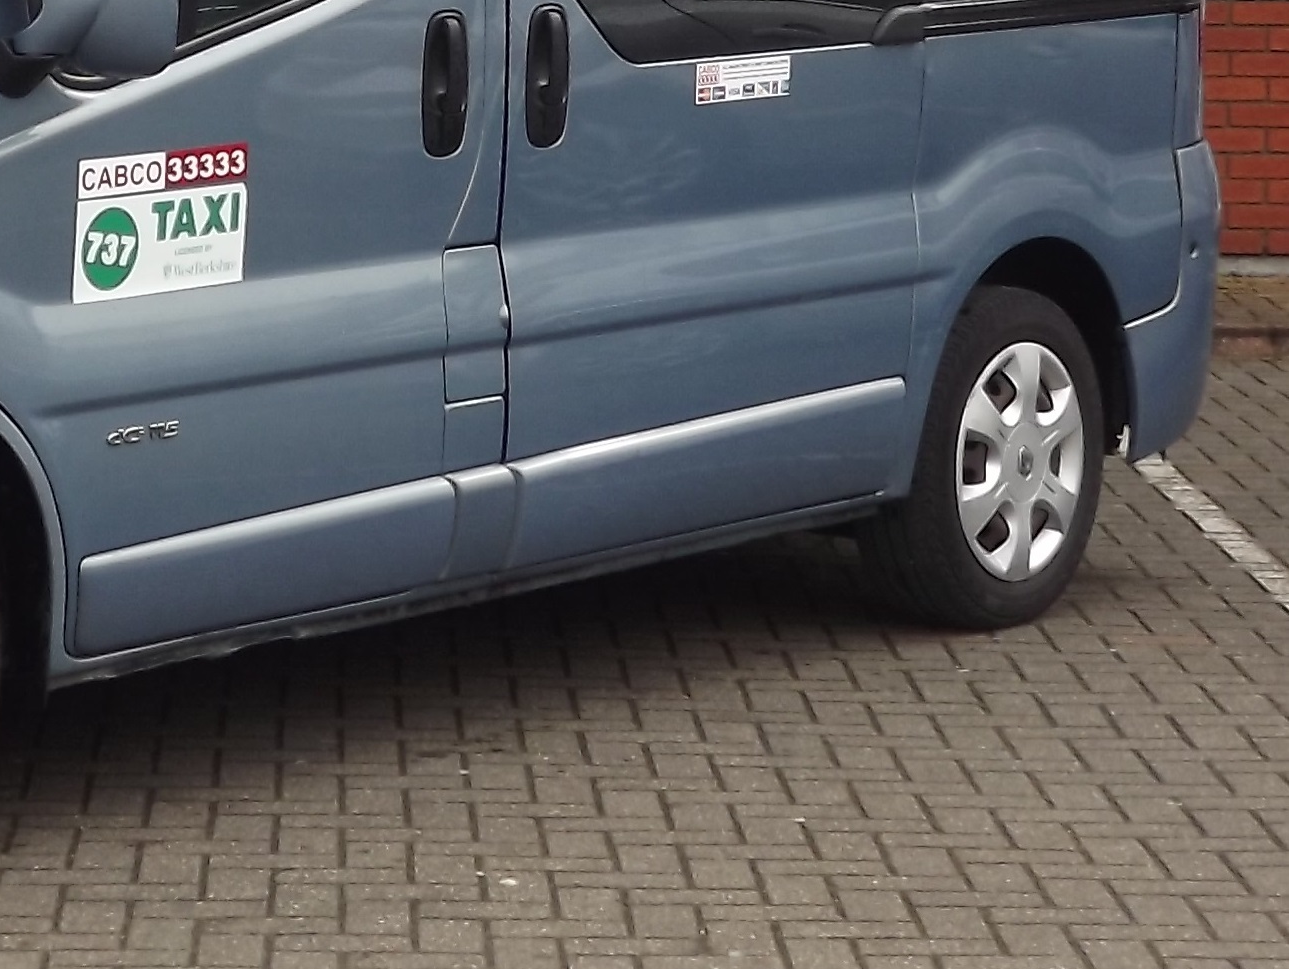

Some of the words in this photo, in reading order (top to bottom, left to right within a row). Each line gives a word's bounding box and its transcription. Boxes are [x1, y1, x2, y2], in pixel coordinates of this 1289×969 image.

[82, 161, 163, 192] CABCO
[167, 149, 246, 183] 33333
[151, 192, 242, 242] TAXI
[85, 231, 137, 267] 737
